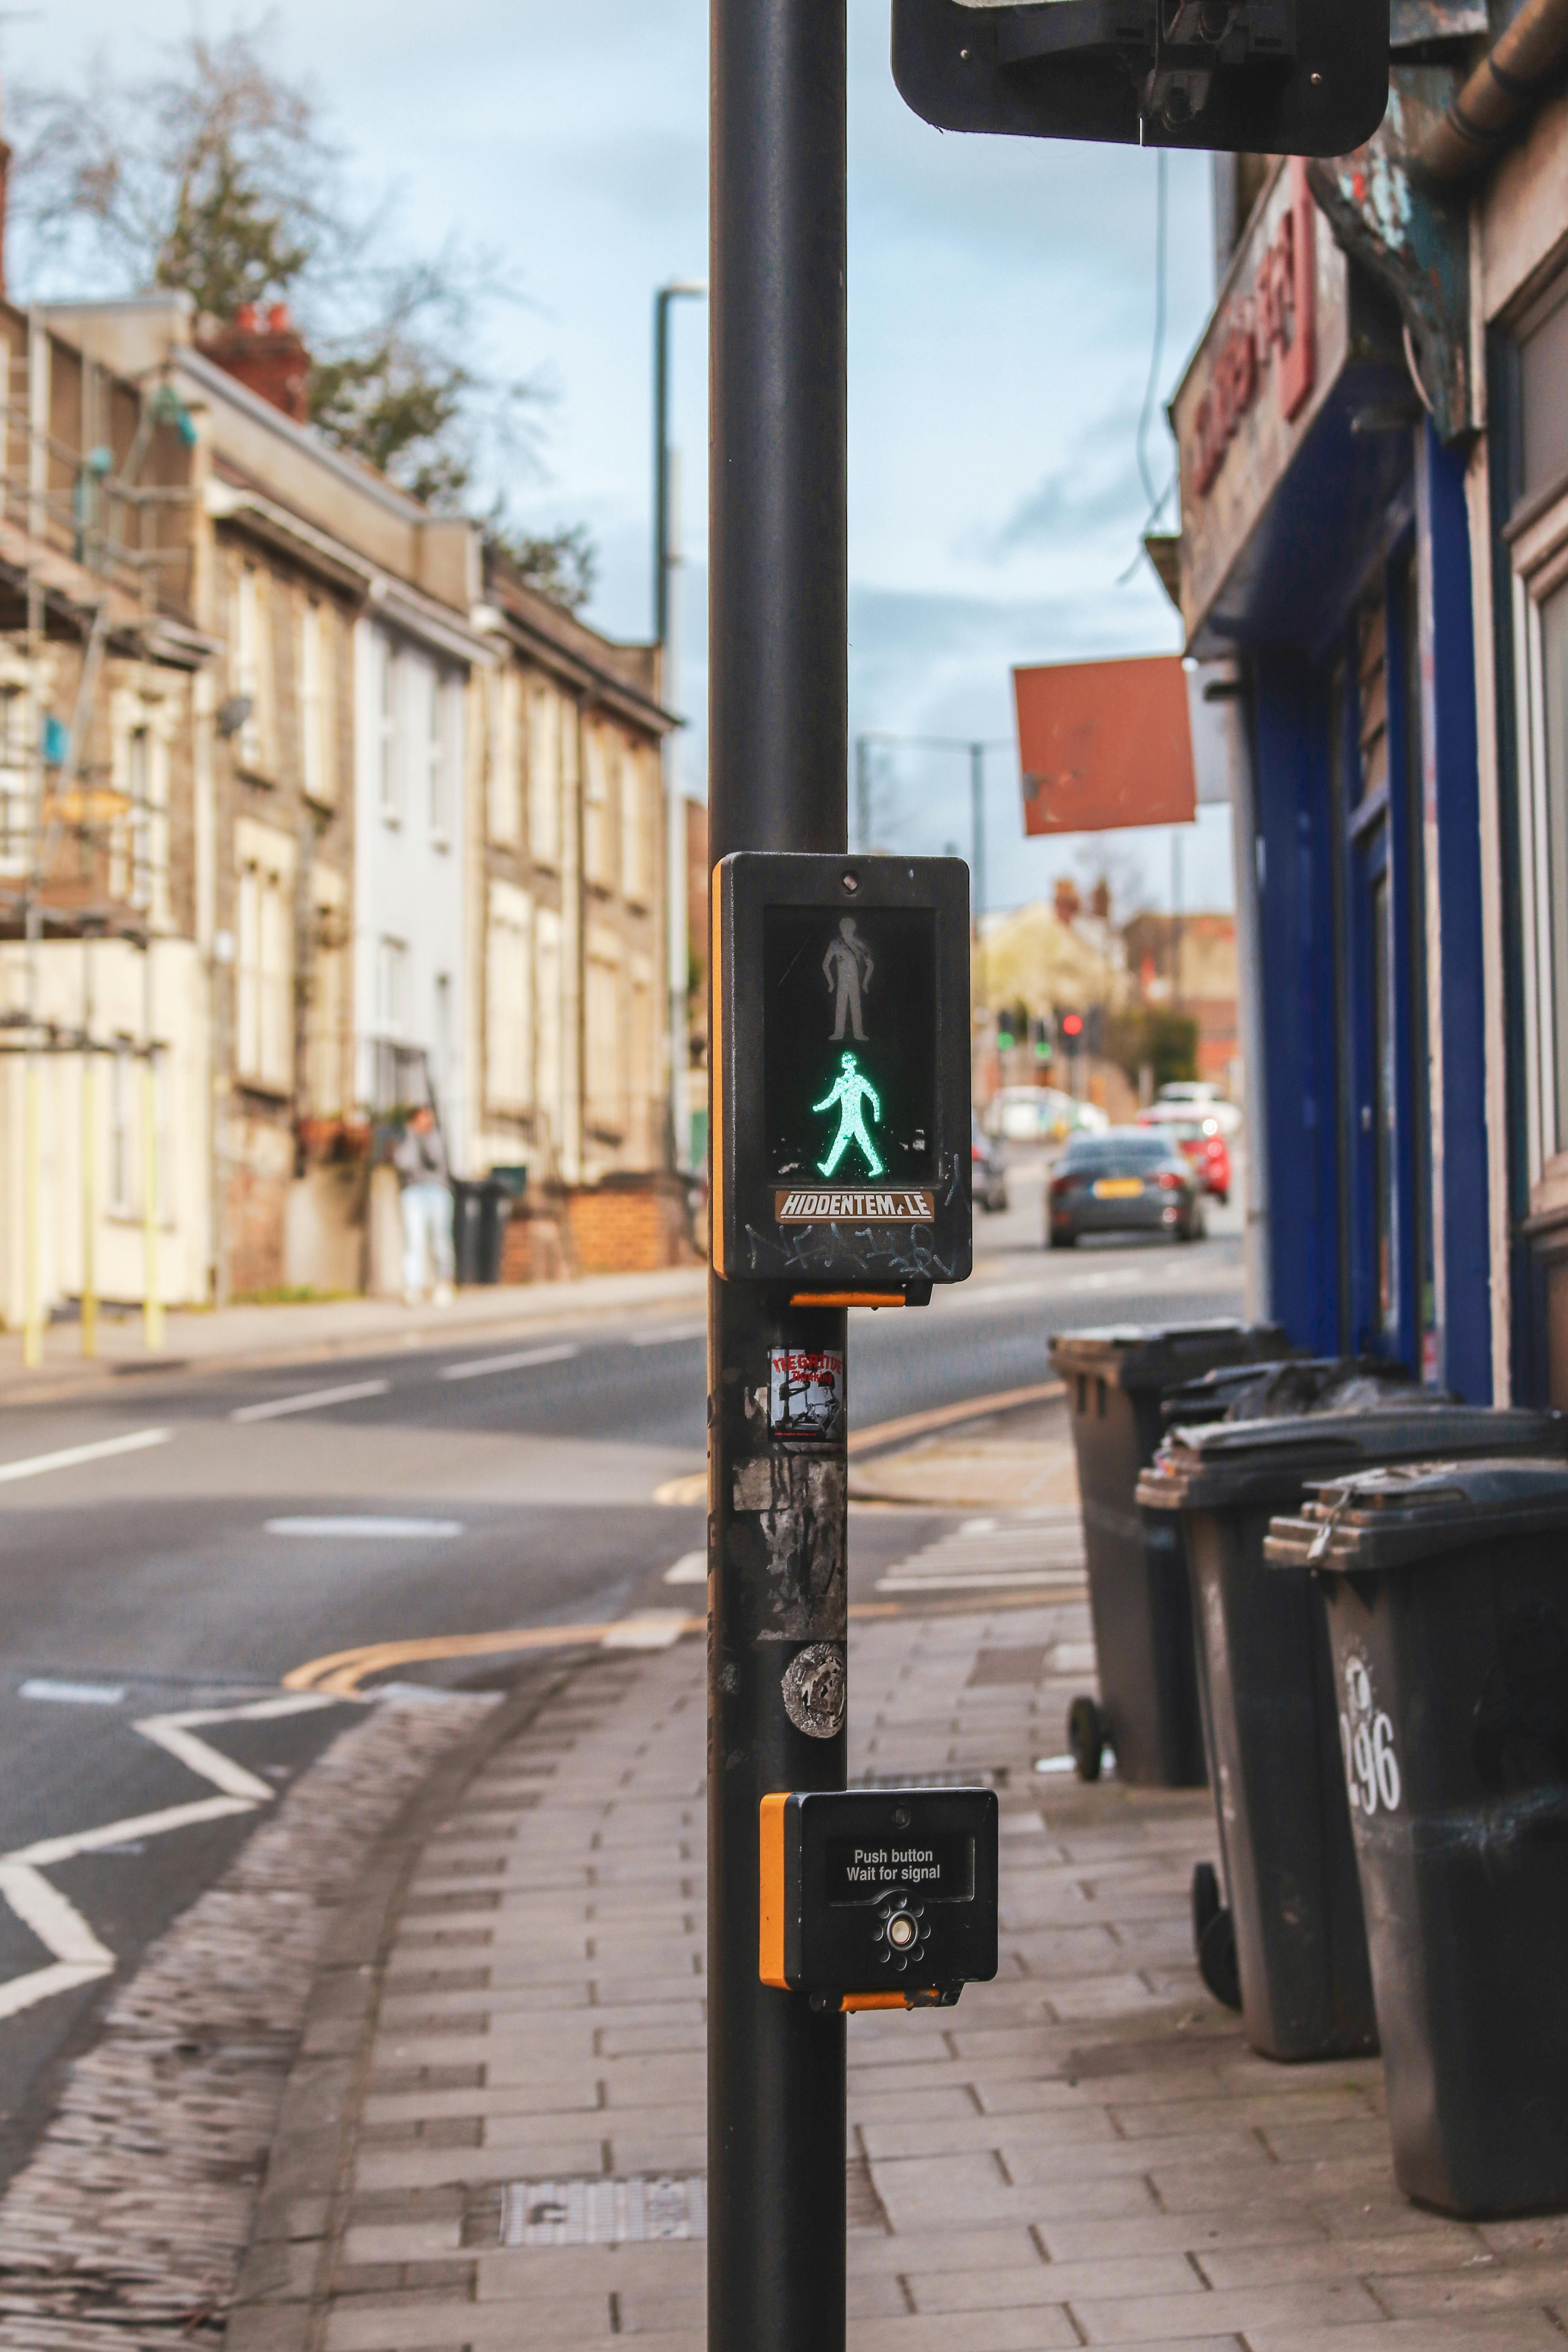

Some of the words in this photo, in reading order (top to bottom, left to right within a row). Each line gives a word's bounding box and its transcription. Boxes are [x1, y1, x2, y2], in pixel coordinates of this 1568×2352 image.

[855, 1849, 887, 1863] Push
[892, 1849, 933, 1862] button
[847, 1867, 876, 1881] Wait
[879, 1866, 898, 1880] for
[901, 1864, 940, 1883] signal
